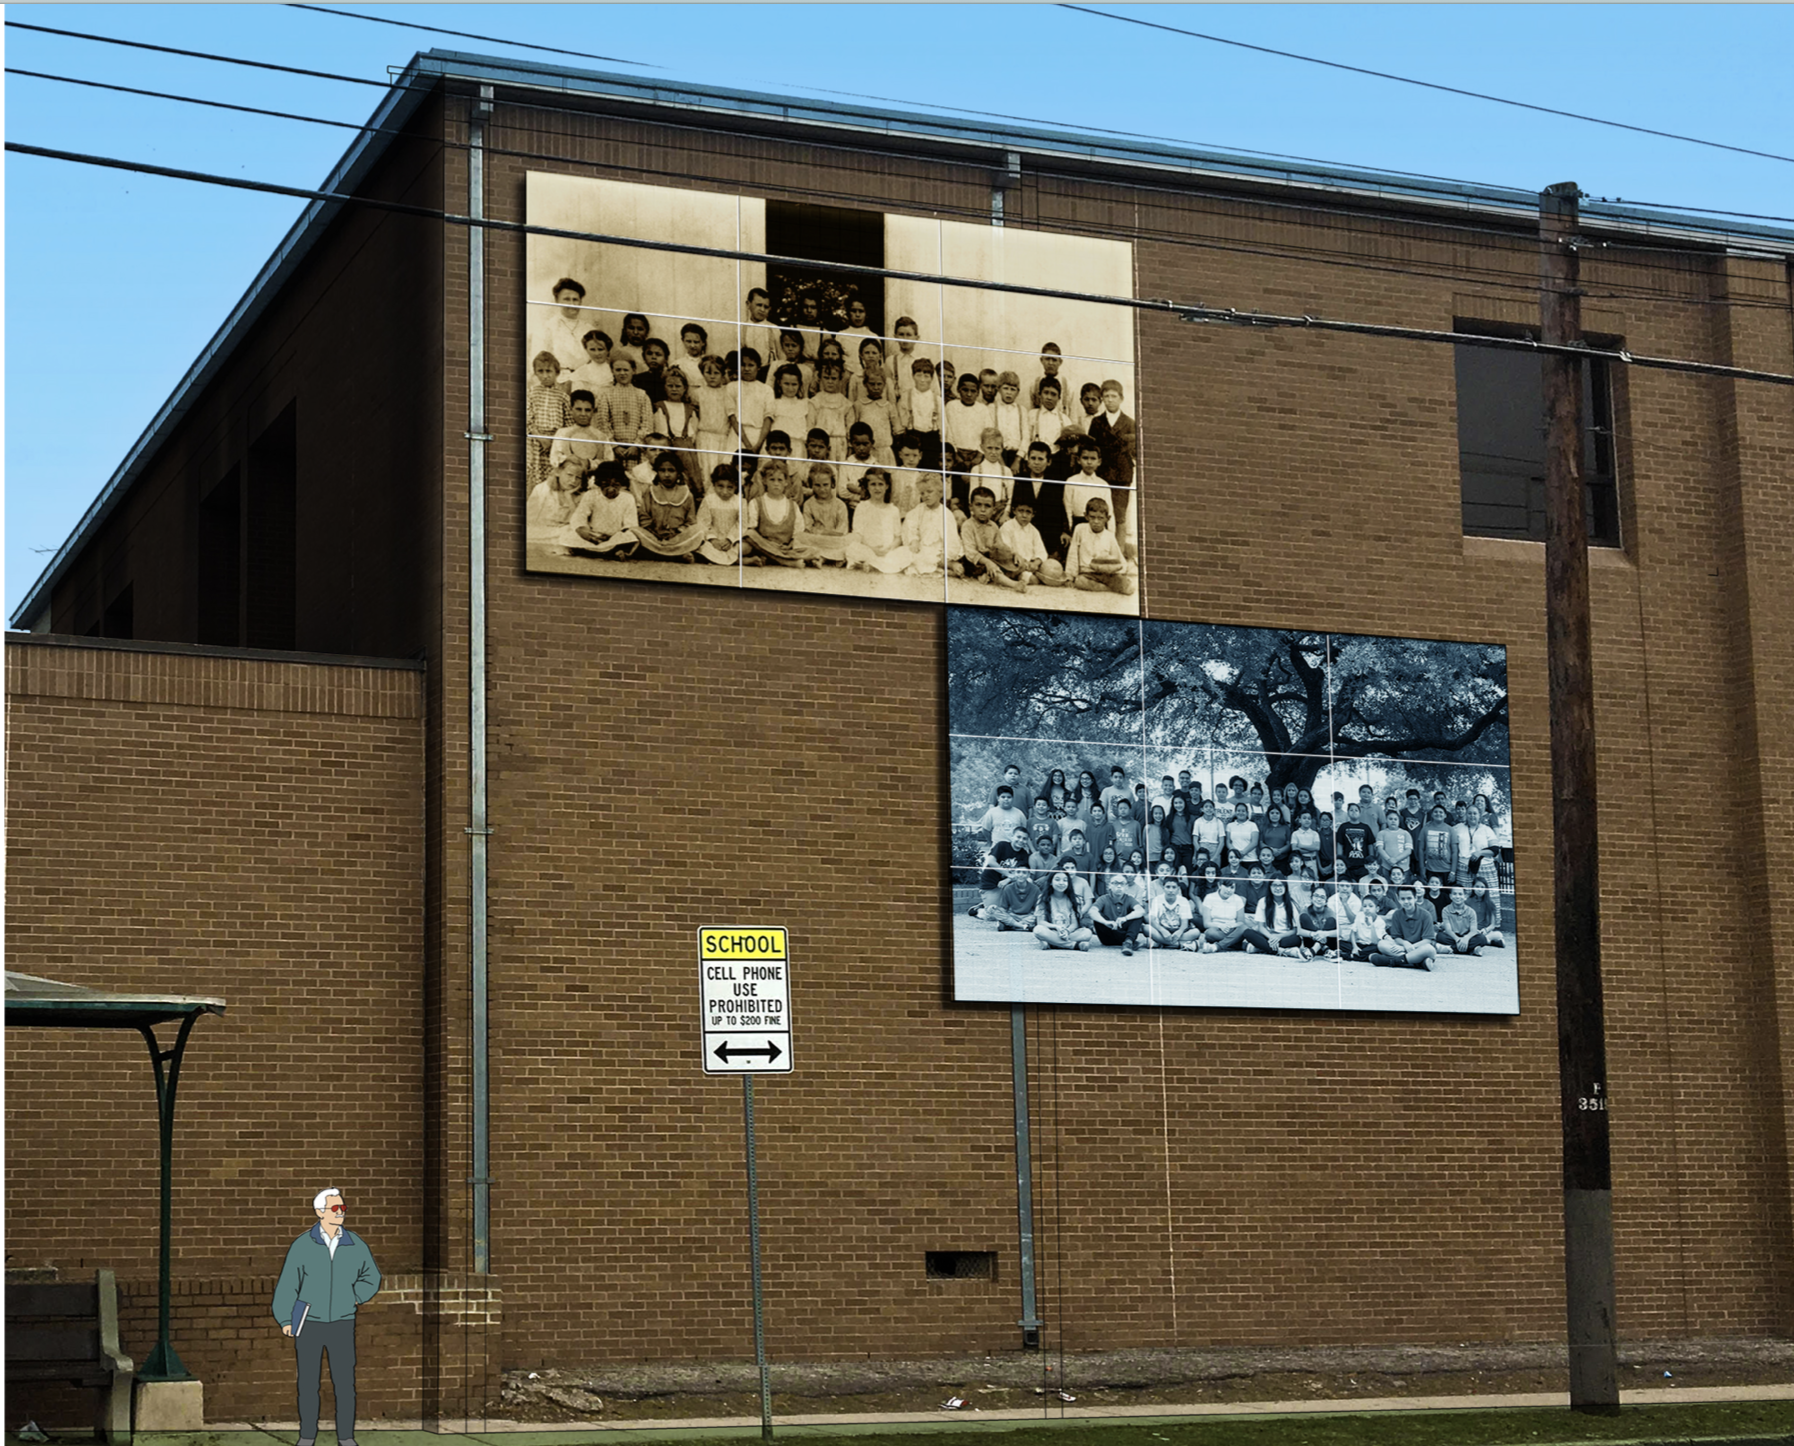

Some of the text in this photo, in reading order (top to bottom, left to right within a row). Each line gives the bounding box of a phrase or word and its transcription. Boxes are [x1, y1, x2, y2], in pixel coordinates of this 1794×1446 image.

[706, 935, 782, 953] SCHOOL
[707, 966, 782, 980] CELL PHONE
[733, 983, 758, 996] USE
[709, 999, 783, 1013] PROHIBITED
[712, 1015, 782, 1026] UP TO $200 FINE
